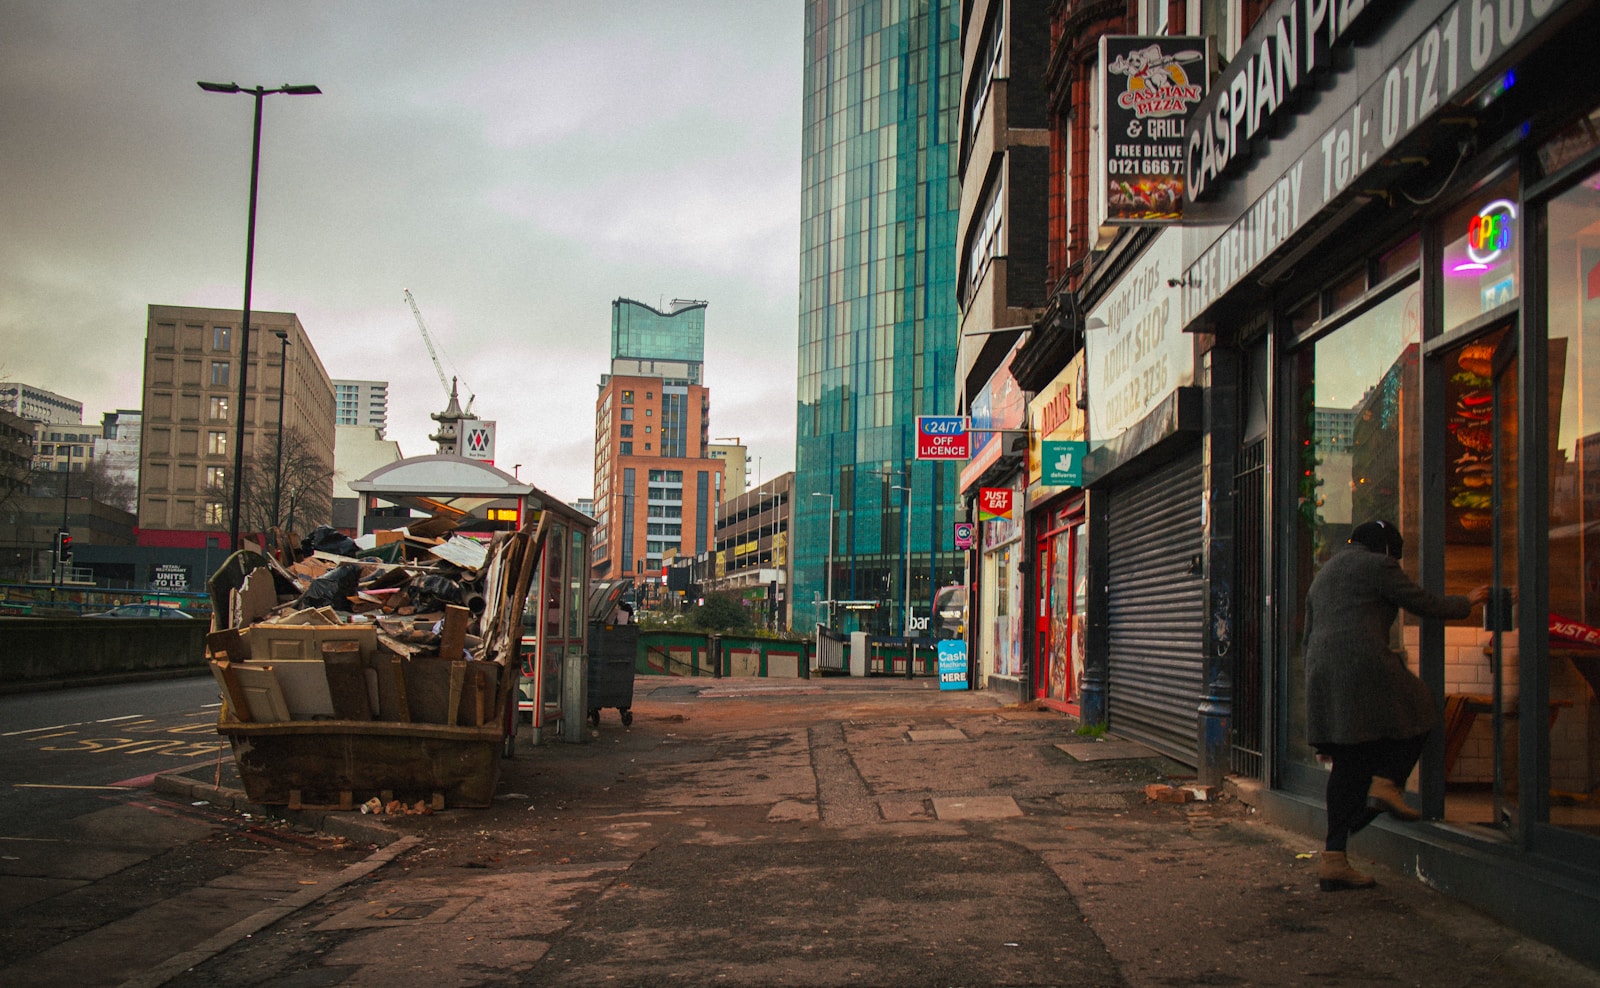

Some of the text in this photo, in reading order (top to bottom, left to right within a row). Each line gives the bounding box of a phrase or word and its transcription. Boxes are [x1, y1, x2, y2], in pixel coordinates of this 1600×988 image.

[1121, 86, 1198, 106] CASPIAN
[1187, 0, 1298, 203] CASPIAN
[1137, 99, 1183, 115] PIZZA
[1126, 119, 1143, 138] &
[1115, 145, 1142, 158] FREE
[1108, 159, 1140, 175] 0121
[1142, 159, 1170, 175] 666
[1184, 243, 1216, 324] FREE
[1219, 159, 1303, 294] DELIVERY
[1321, 104, 1369, 203] Tel:
[1382, 5, 1459, 149] 0121
[1107, 259, 1160, 337] Night Trips
[1103, 297, 1169, 391] ADULT SHOP
[930, 421, 958, 434] 24/7
[933, 436, 953, 446] OFF
[921, 446, 966, 456] LICENCE
[984, 490, 1009, 501] JUST
[988, 500, 1009, 509] EAT
[155, 579, 168, 587] TO
[909, 606, 931, 631] bar
[1548, 621, 1587, 639] JUST
[939, 651, 966, 662] Cash
[941, 672, 967, 683] HERE
